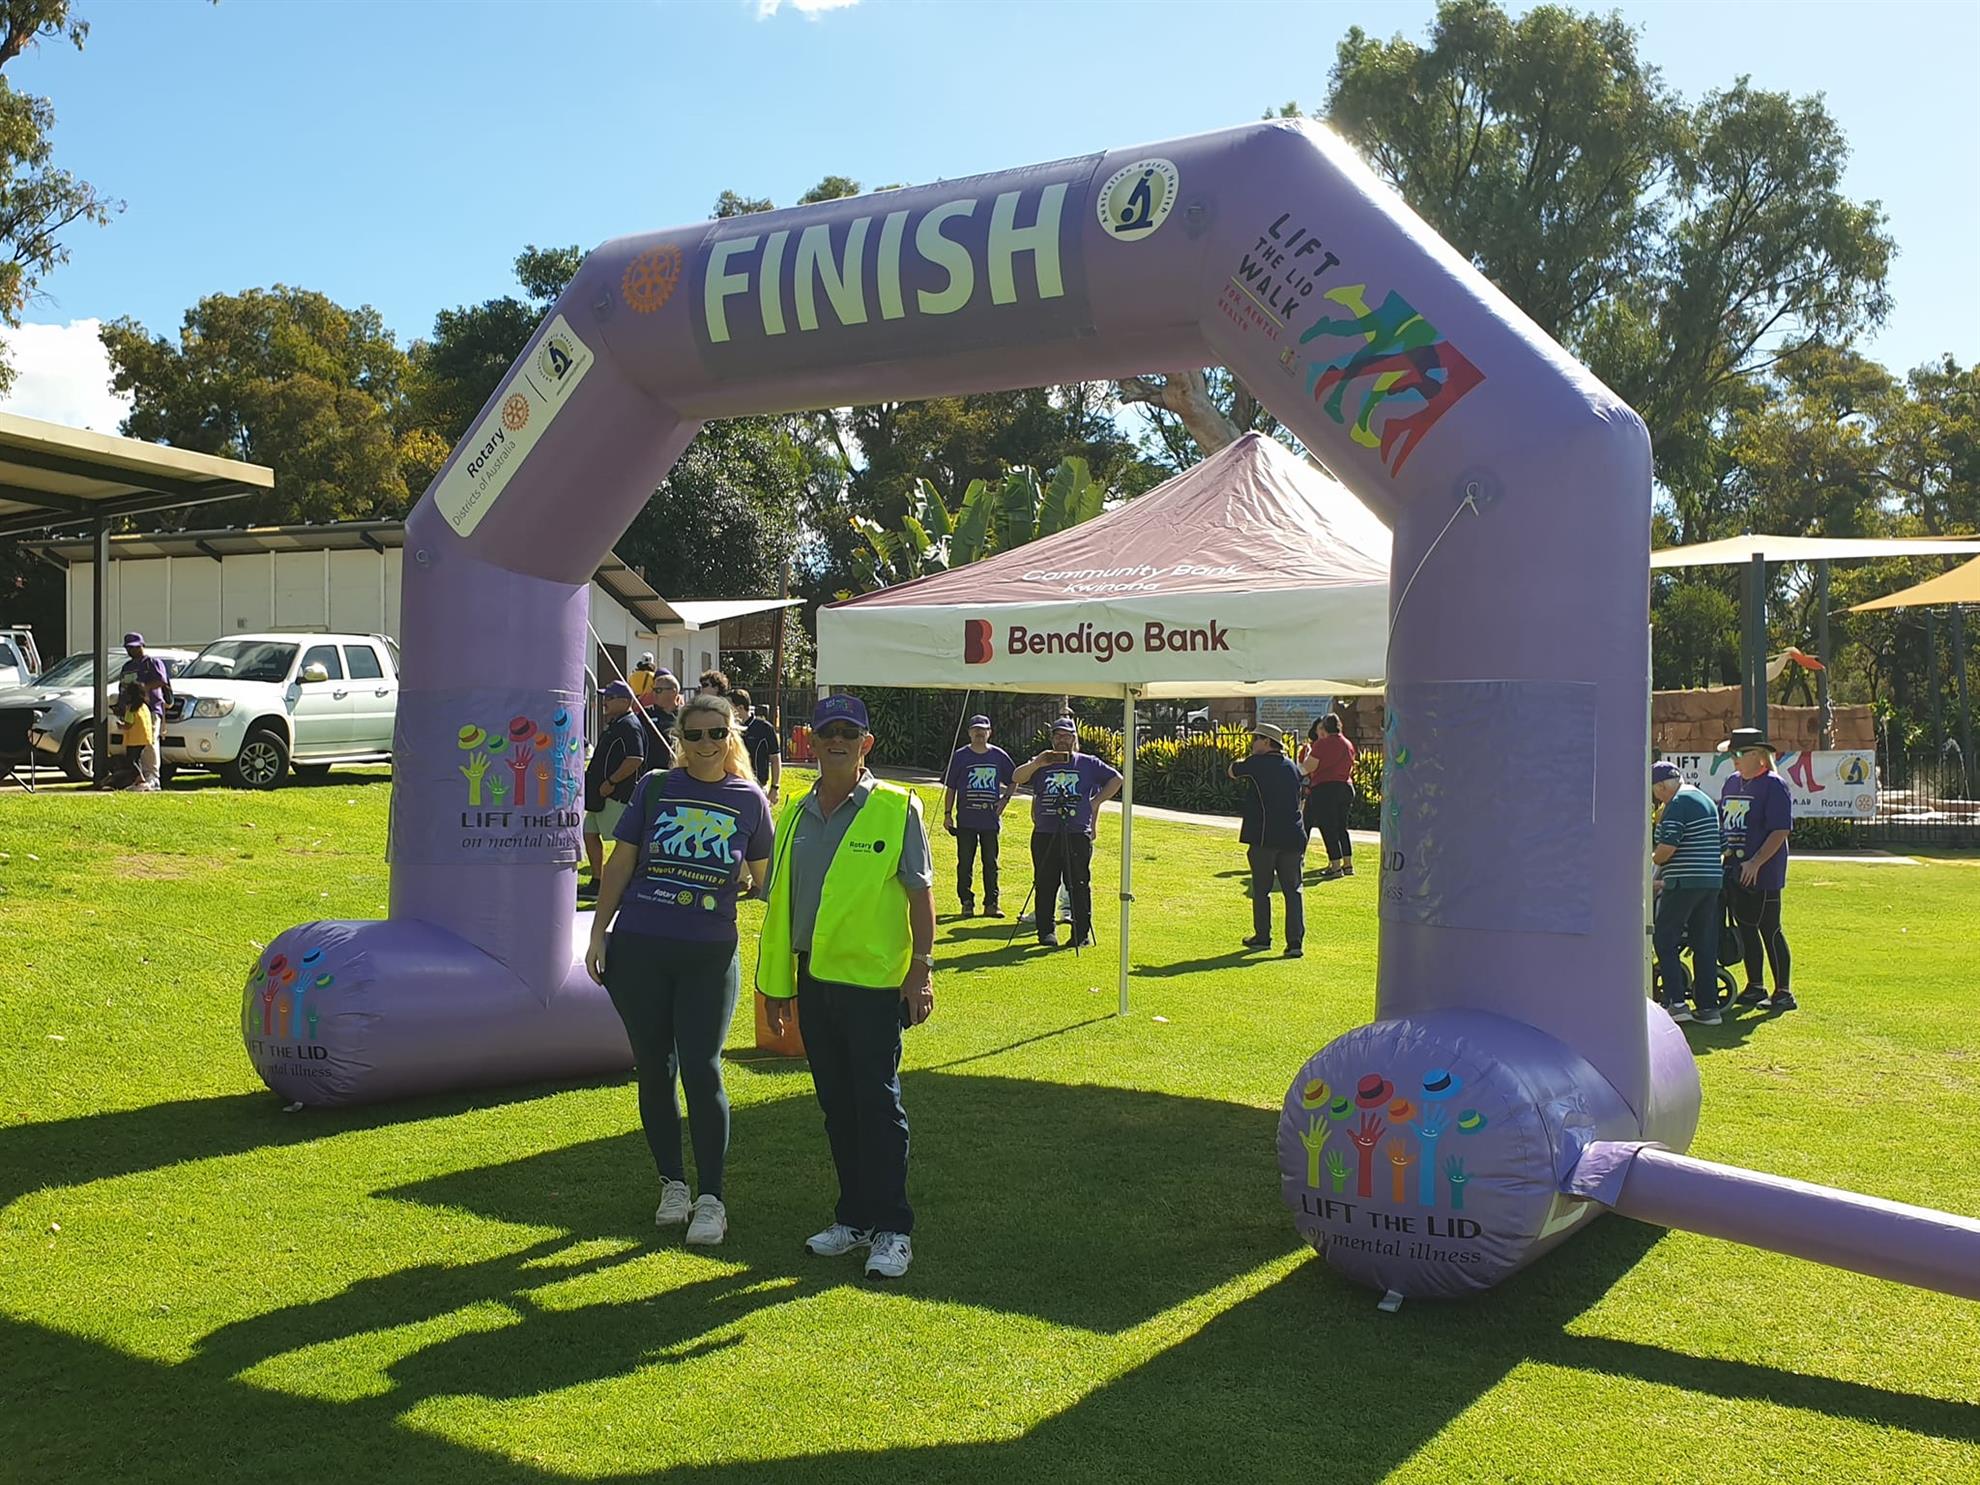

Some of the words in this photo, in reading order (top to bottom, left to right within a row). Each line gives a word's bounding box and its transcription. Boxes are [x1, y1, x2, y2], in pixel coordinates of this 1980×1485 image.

[1268, 213, 1340, 277] LIFT
[704, 183, 1070, 343] FINISH
[1254, 237, 1284, 269] THE
[1285, 268, 1313, 297] LID
[1239, 254, 1300, 320] WALK
[467, 427, 506, 478] Rotary
[453, 489, 481, 526] Districts
[479, 477, 489, 491] of
[488, 440, 516, 481] Australia
[1022, 564, 1169, 582] Community
[1170, 564, 1245, 576] Bank
[1063, 582, 1161, 593] Kwinana
[1008, 622, 1134, 662] Bendigo
[1144, 619, 1230, 652] Bank
[1821, 799, 1853, 808] Rotary
[461, 812, 512, 827] LIFT
[521, 815, 551, 827] THE
[558, 812, 580, 827] LID
[462, 837, 482, 848] on
[488, 833, 542, 848] mental
[850, 841, 871, 849] Rotary
[654, 889, 677, 900] Rotary
[270, 1046, 292, 1058] THE
[298, 1045, 328, 1060] LID
[290, 1064, 332, 1078] illness
[1301, 1194, 1357, 1224] LIFT
[1366, 1211, 1416, 1234] THE
[1427, 1215, 1482, 1240] LID
[1307, 1227, 1327, 1242] on
[1332, 1233, 1400, 1257] mental
[1409, 1242, 1482, 1264] illness
